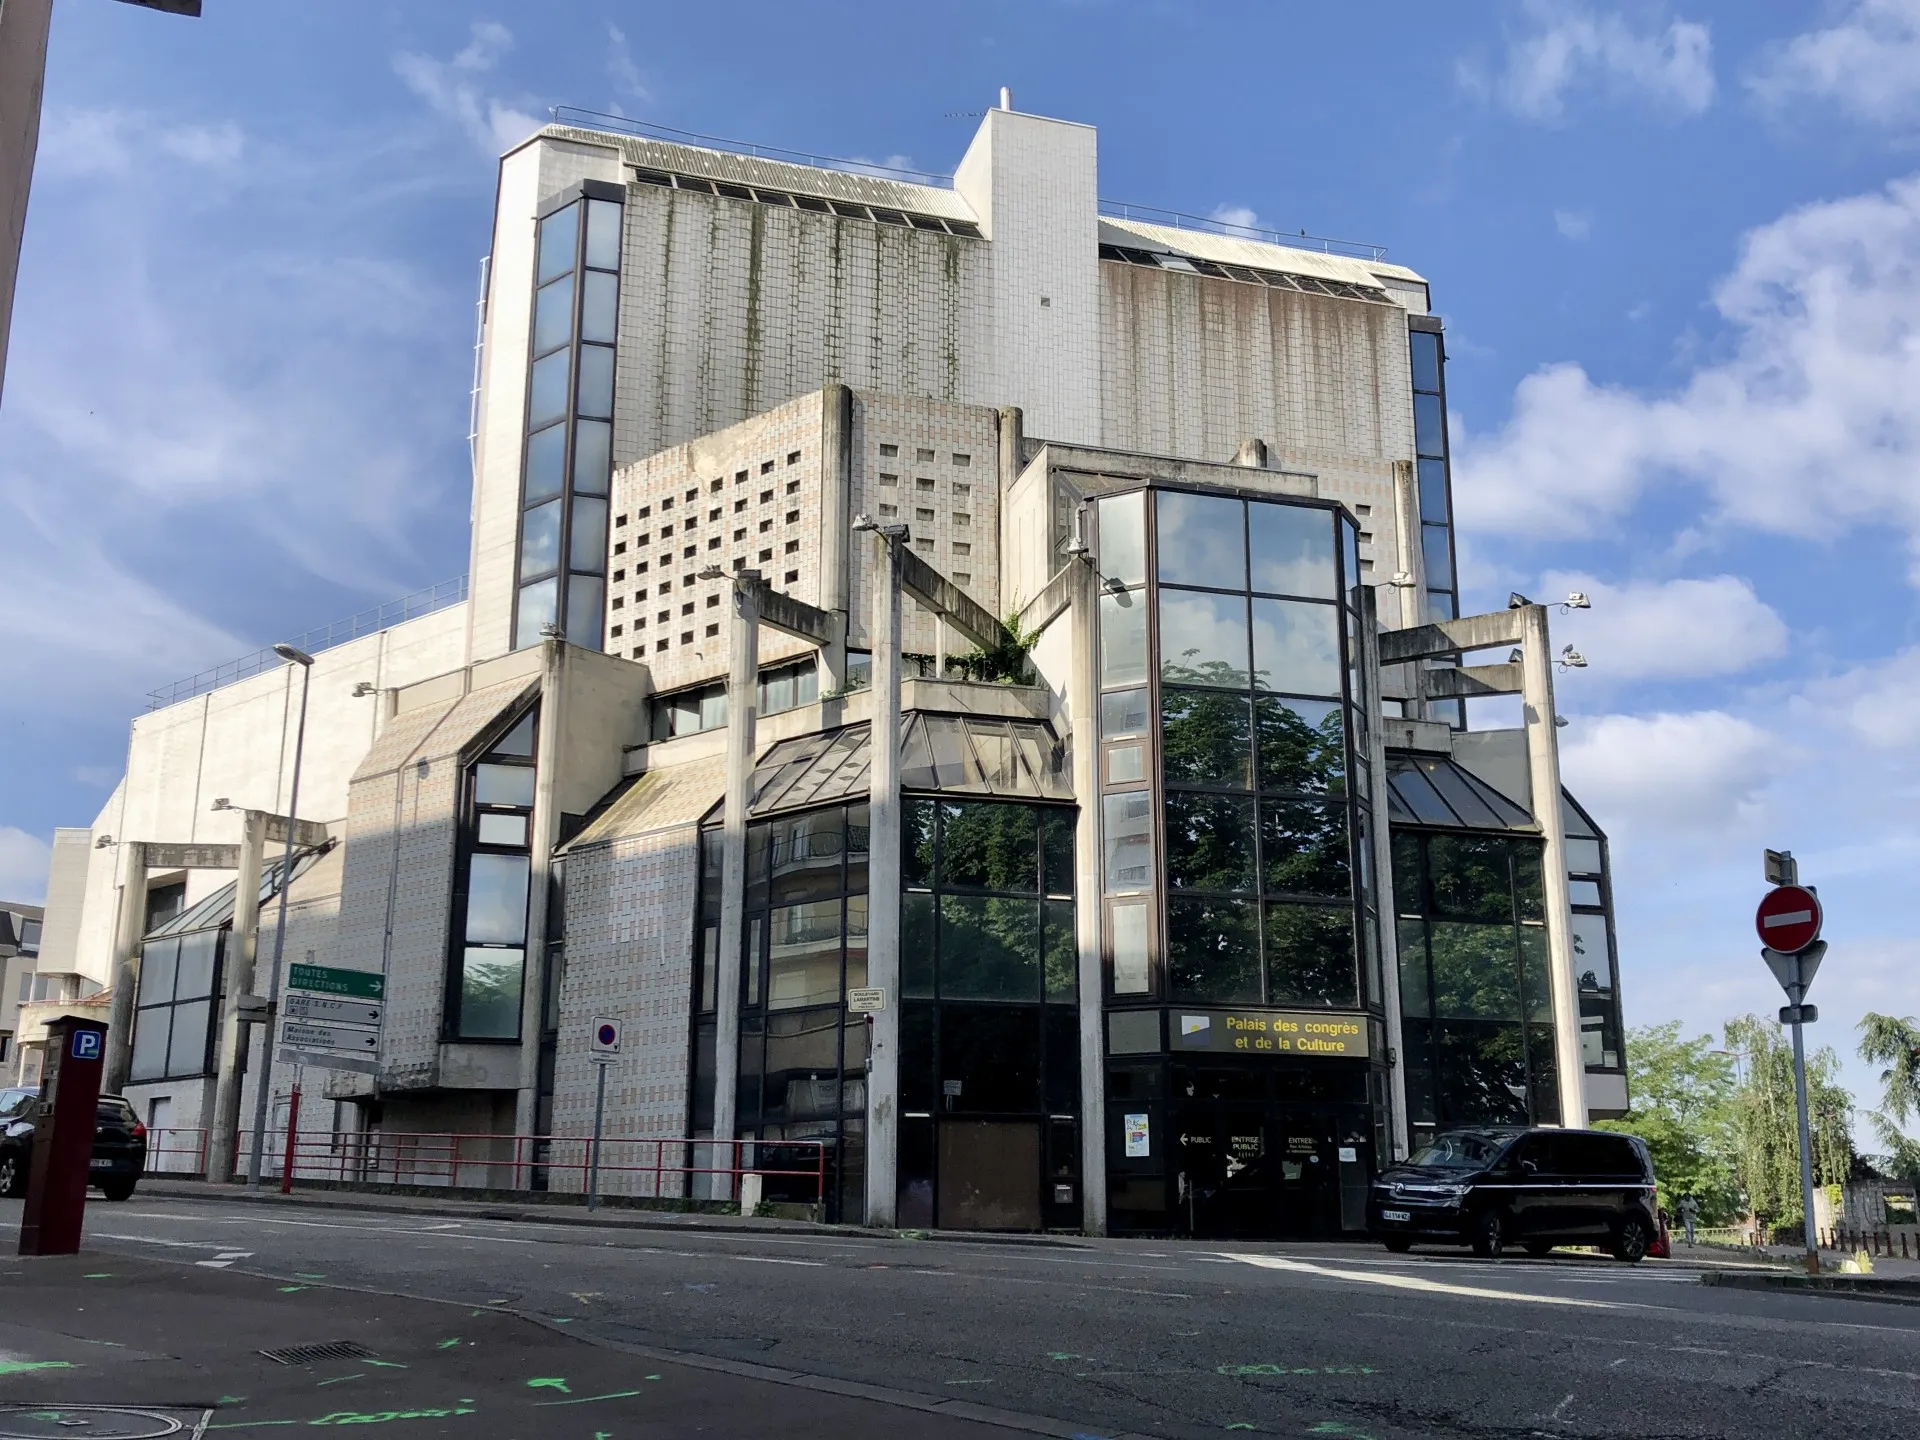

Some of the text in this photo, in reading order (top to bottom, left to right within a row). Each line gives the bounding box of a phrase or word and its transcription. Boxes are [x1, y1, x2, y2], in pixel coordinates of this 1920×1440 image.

[293, 966, 328, 979] TOUTES
[291, 977, 349, 991] DIRECTIONS
[287, 1026, 315, 1034] Maison
[1226, 1017, 1359, 1036] Palais des congrès
[286, 1034, 335, 1045] Associations
[1235, 1037, 1345, 1052] et de la Culture
[1190, 1136, 1212, 1144] PUBLIC
